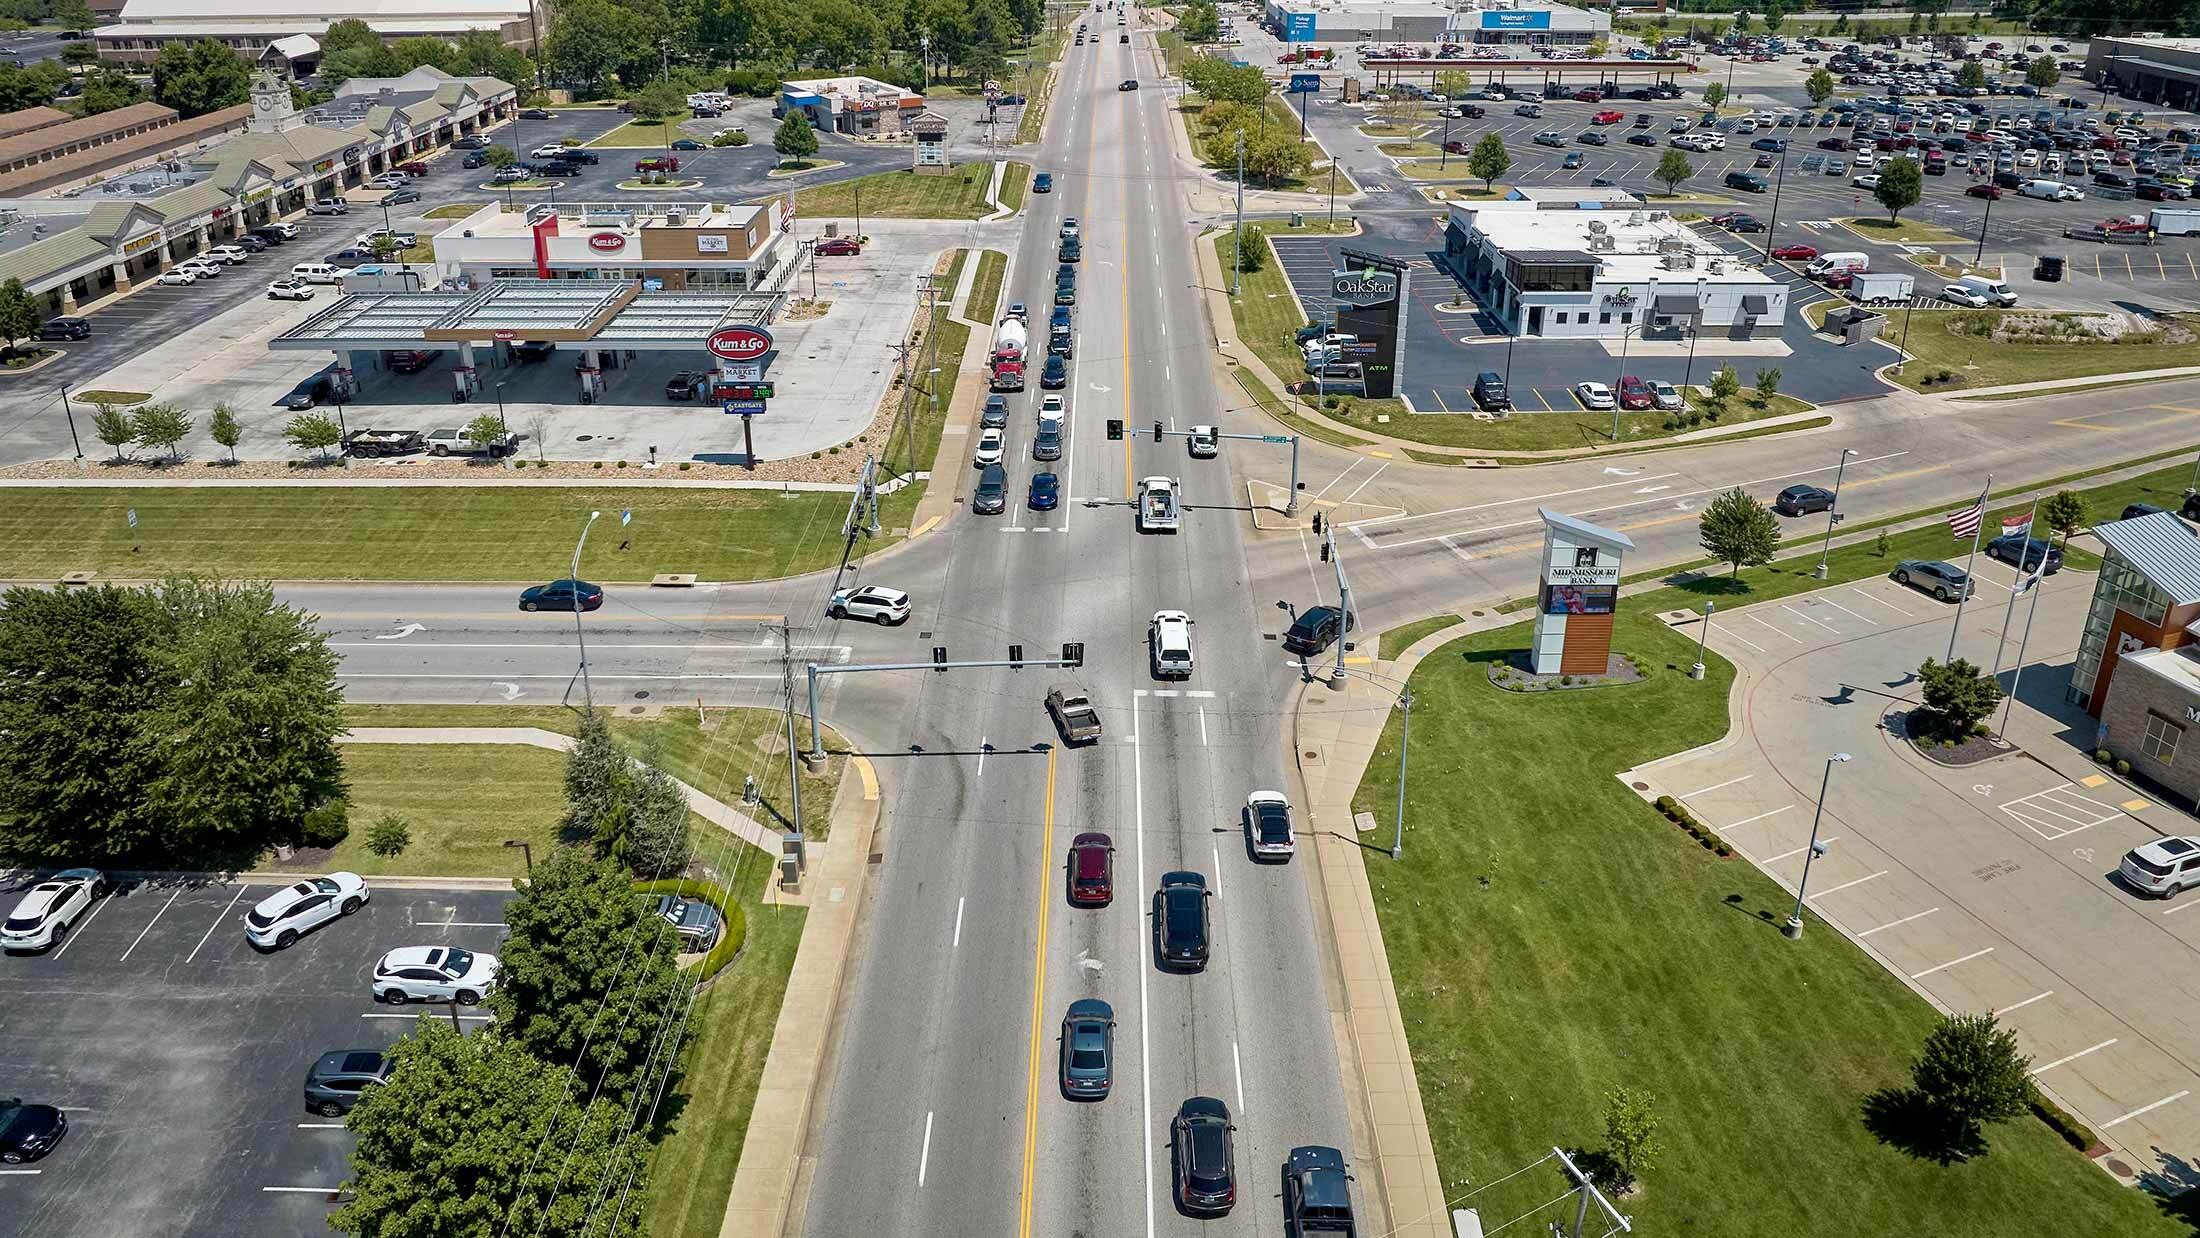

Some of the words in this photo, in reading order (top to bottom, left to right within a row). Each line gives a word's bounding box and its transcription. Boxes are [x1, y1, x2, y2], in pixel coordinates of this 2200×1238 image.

[1337, 279, 1394, 293] OakStar
[713, 337, 738, 351] Kum
[748, 337, 764, 351] Go
[1552, 568, 1617, 576] MID-MISSOURI
